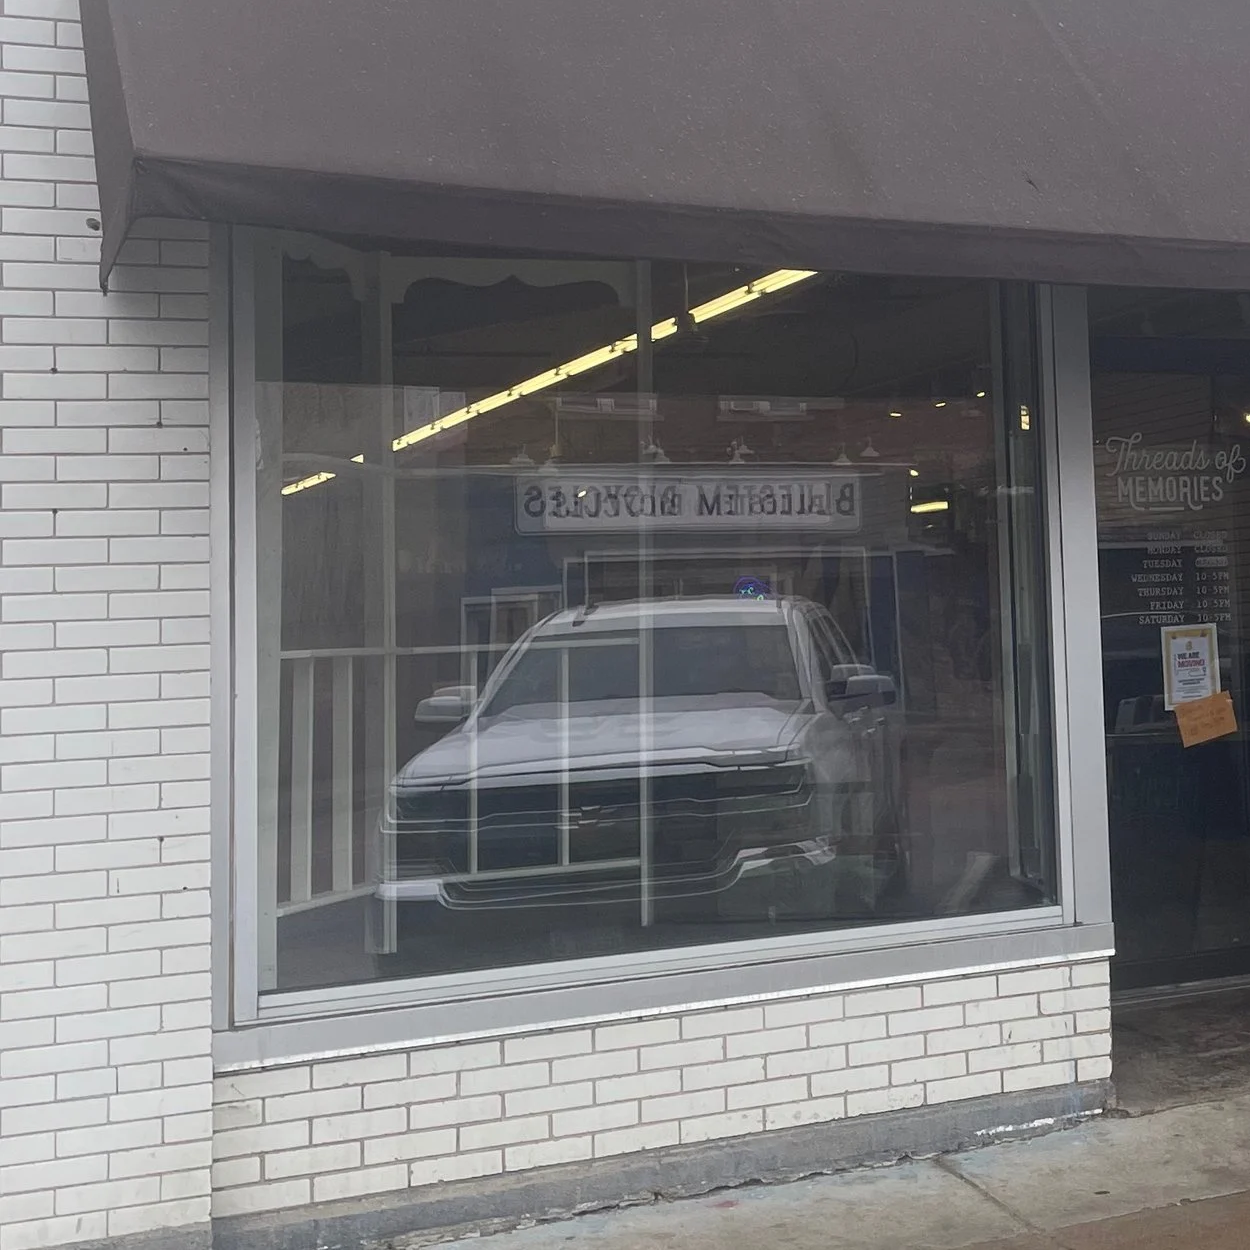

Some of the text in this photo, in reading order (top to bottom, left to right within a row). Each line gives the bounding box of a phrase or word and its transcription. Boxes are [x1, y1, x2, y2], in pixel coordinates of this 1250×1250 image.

[1106, 432, 1247, 482] Threads of
[1117, 475, 1224, 511] MEMORIES
[1142, 559, 1183, 569] TUESDAY
[1130, 572, 1184, 583] WEDNESDAY
[1137, 587, 1184, 597] THURSDAY
[1150, 601, 1185, 611] FRIDAY
[1138, 614, 1185, 625] SATURDAY
